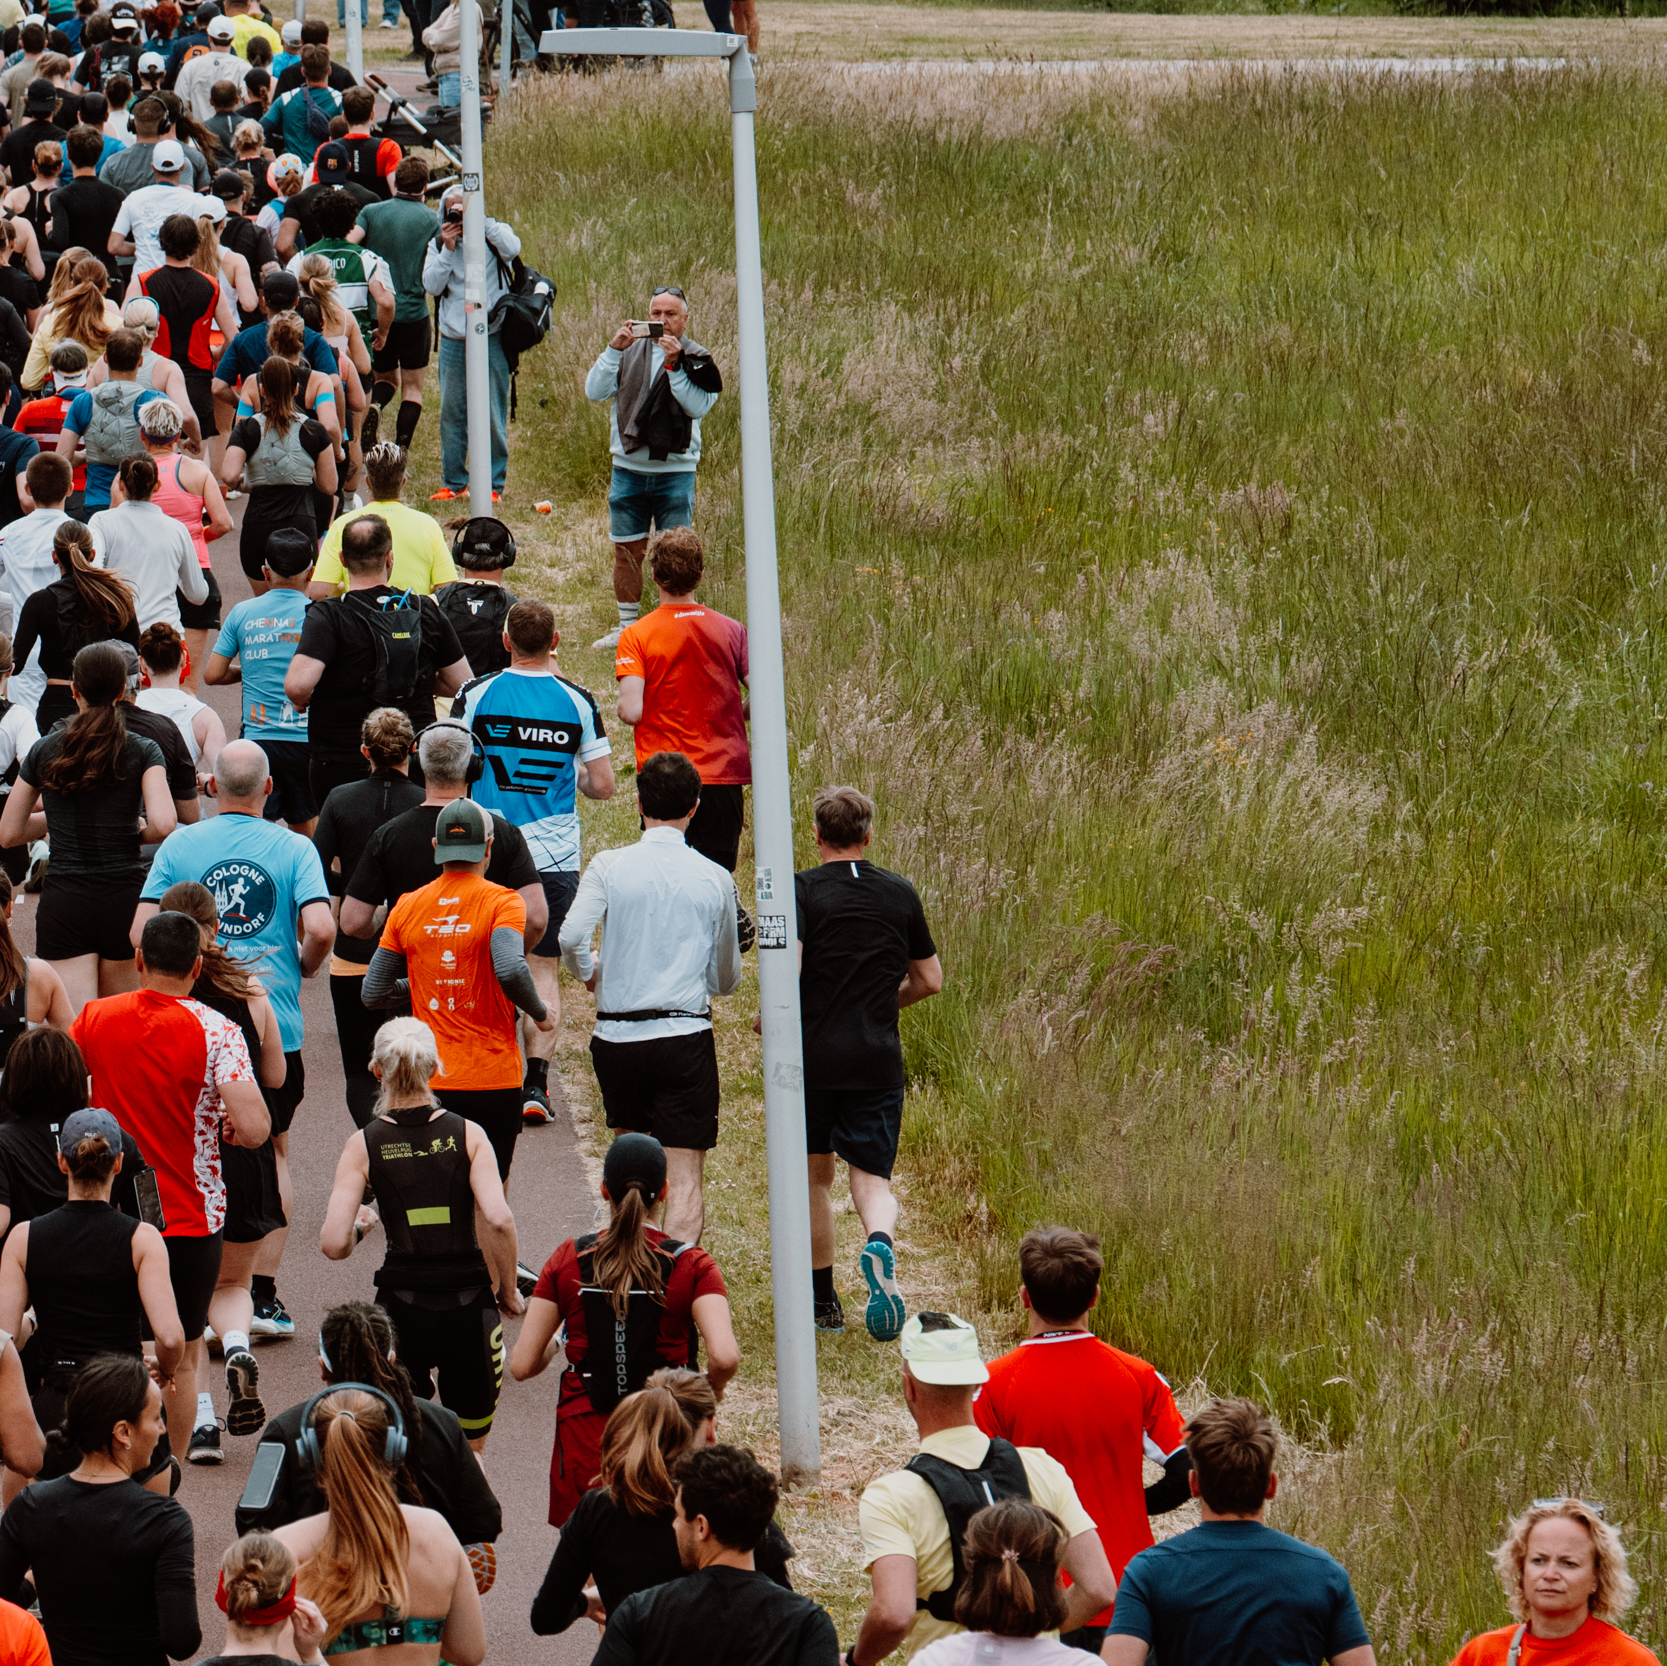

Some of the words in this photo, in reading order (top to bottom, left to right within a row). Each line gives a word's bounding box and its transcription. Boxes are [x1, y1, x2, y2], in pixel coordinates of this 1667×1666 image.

[245, 617, 296, 631] CHENNAI
[245, 649, 269, 660] CLUB
[517, 726, 570, 745] VIRO
[206, 864, 265, 887] COLOGNE
[382, 1152, 414, 1161] TRIATHLON
